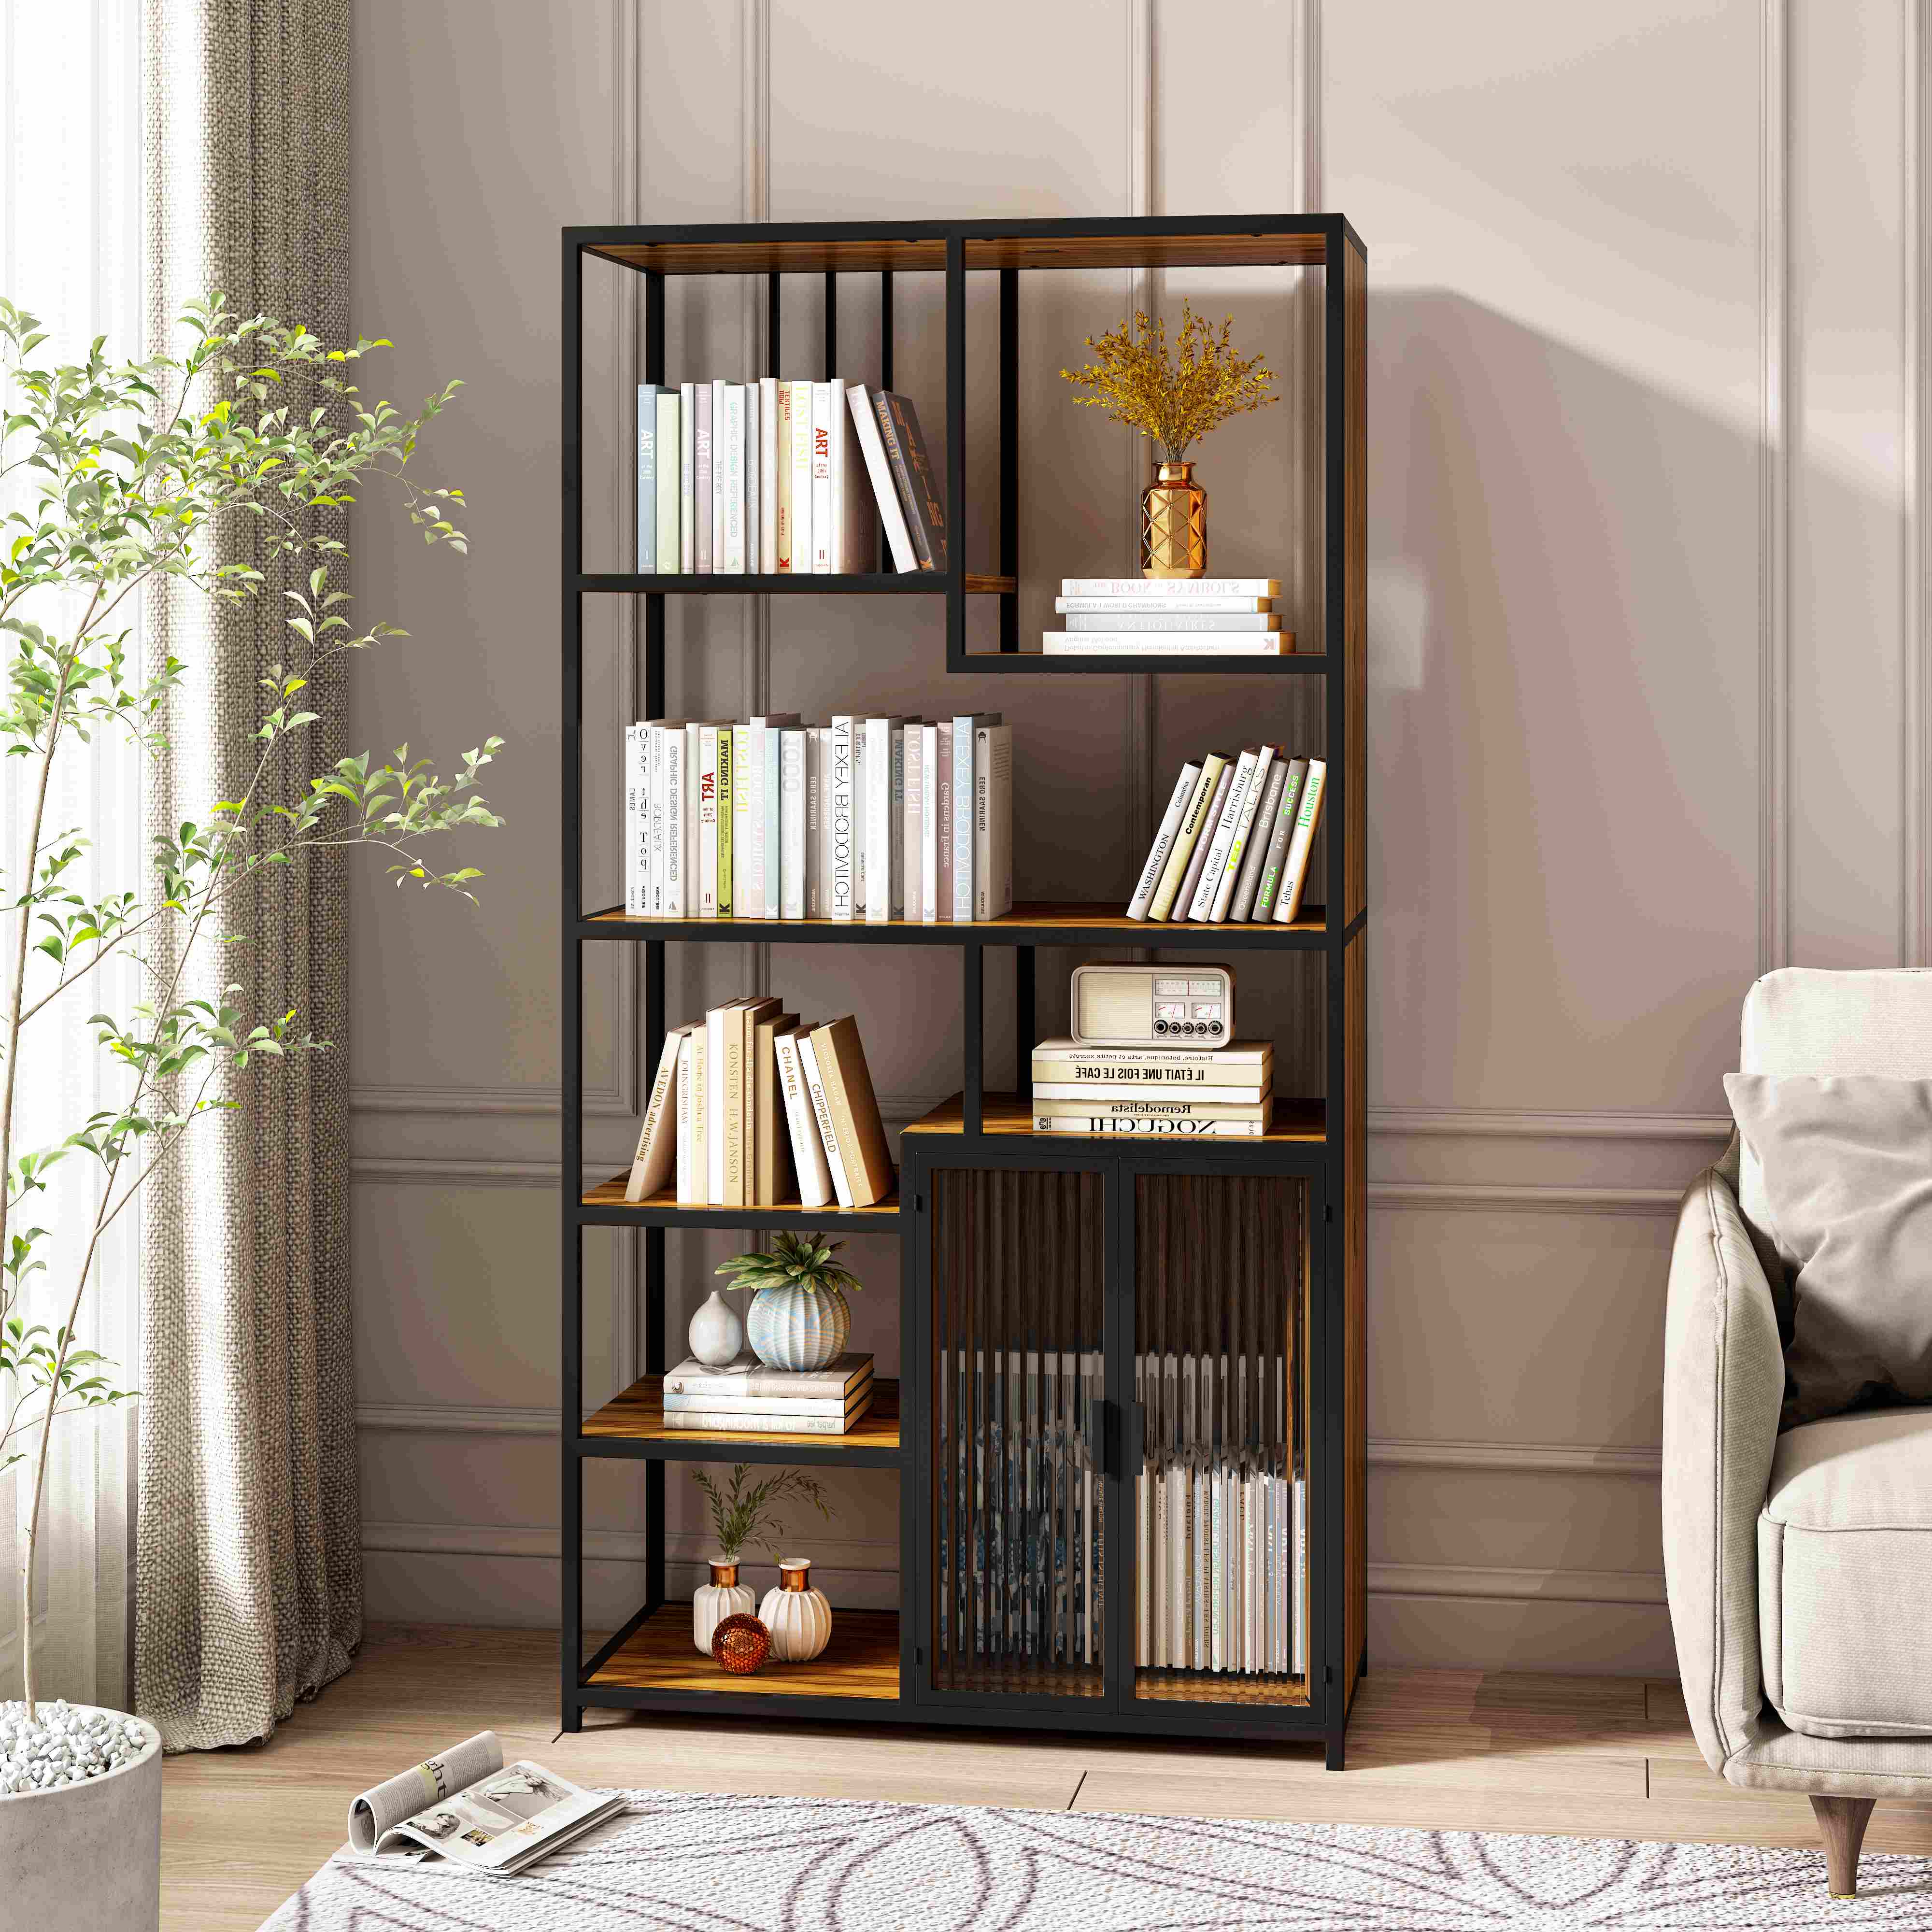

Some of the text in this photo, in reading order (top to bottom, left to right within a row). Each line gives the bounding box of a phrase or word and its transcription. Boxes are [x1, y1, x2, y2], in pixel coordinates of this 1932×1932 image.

[641, 429, 653, 459] ART
[697, 429, 710, 459] ART
[815, 428, 828, 457] ART
[876, 400, 900, 460] MAKING IT
[730, 402, 738, 538] GRAPHIC DESIGN REFERENCED
[1138, 833, 1169, 900] WASHINGTON
[1175, 780, 1189, 808] Columbia
[1186, 777, 1212, 835] Contemporan
[1198, 778, 1228, 852] FORM STYLE
[1198, 766, 1252, 908] State Capital Harrisburg
[1226, 768, 1265, 872] TED TALKS
[1240, 773, 1281, 910] Queensland Brisbane
[1261, 774, 1299, 909] FORMULA FOR SUCCESS
[1280, 777, 1320, 906] Tehas Houston
[728, 1044, 739, 1099] KONSTEN
[781, 1046, 798, 1100] CHANEL
[636, 1066, 669, 1162] AVEDON advertising
[812, 1083, 837, 1153] CHIPPERFIELD
